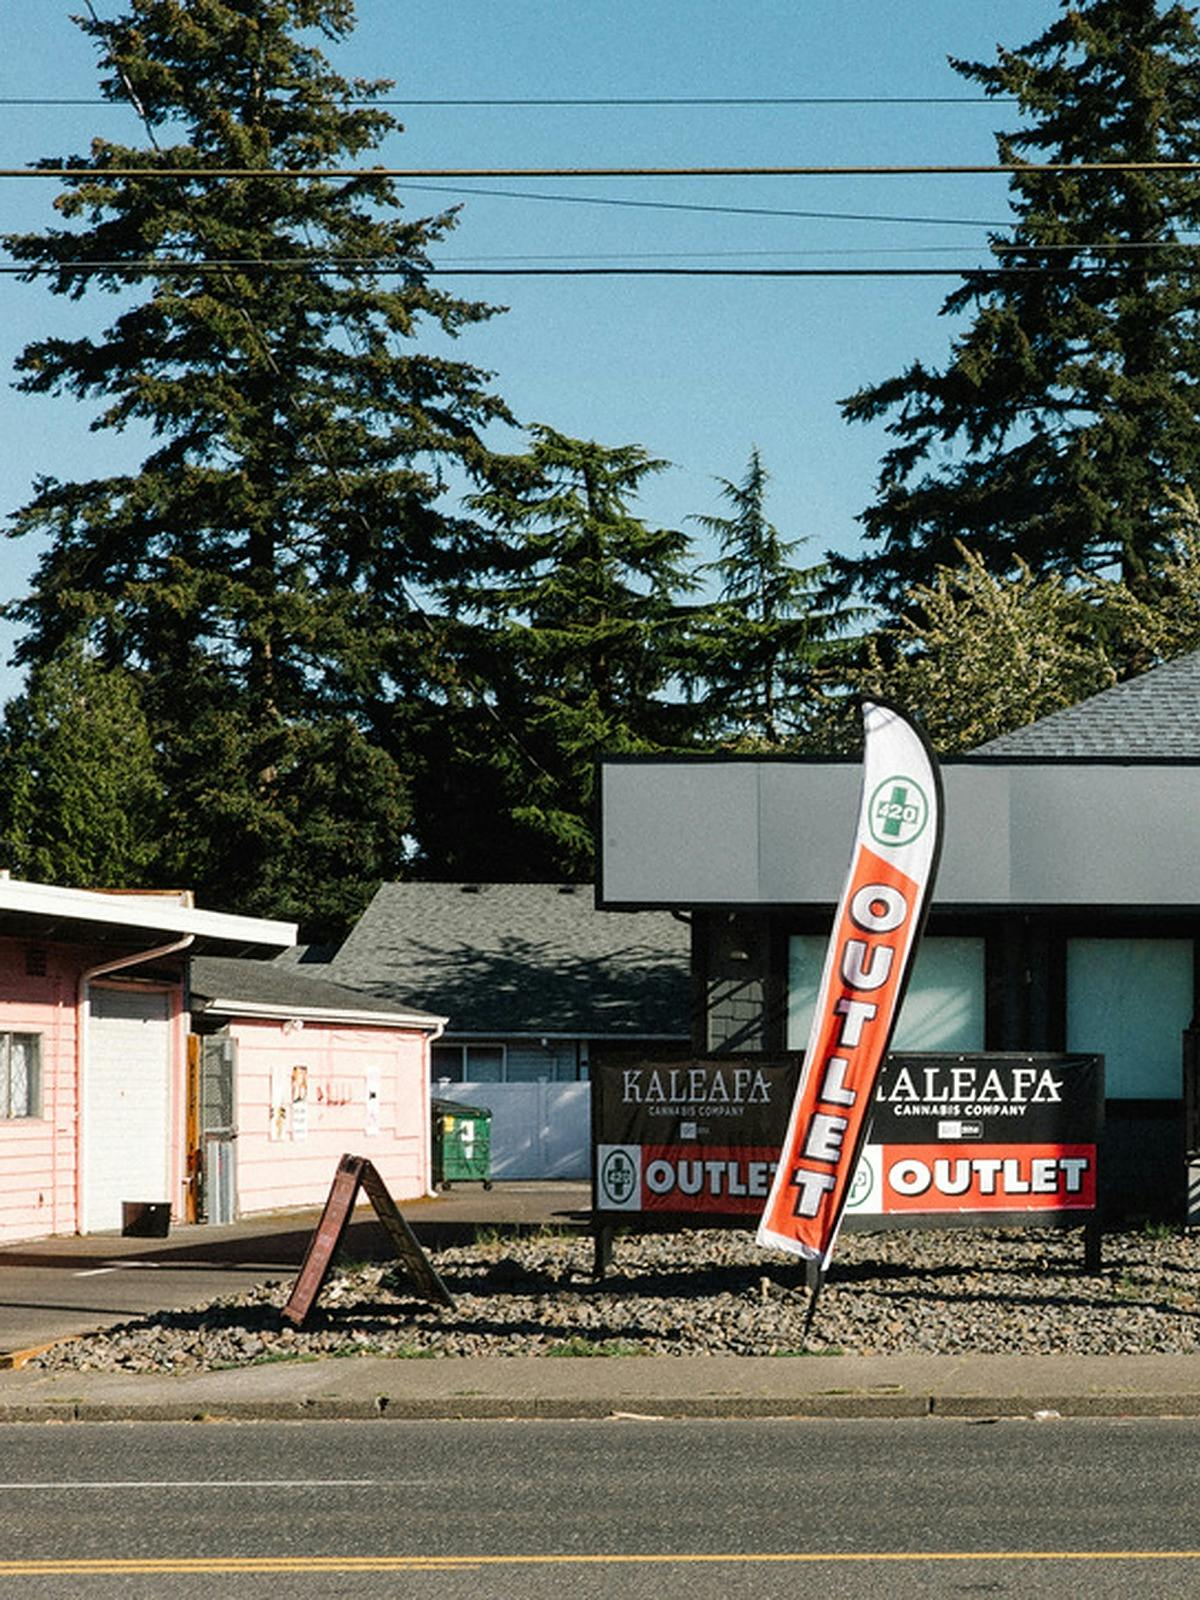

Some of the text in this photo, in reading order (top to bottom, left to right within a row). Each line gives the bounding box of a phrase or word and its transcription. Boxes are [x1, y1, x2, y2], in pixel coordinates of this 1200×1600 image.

[878, 803, 917, 823] 420
[793, 884, 908, 1218] OUTLET
[622, 1069, 772, 1102] KALEAFA
[649, 1106, 744, 1116] CANNABIS COMPANY
[894, 1104, 1027, 1116] CANNABIS COMPANY
[646, 1160, 778, 1195] OUTLE
[888, 1158, 1088, 1195] OUTLET
